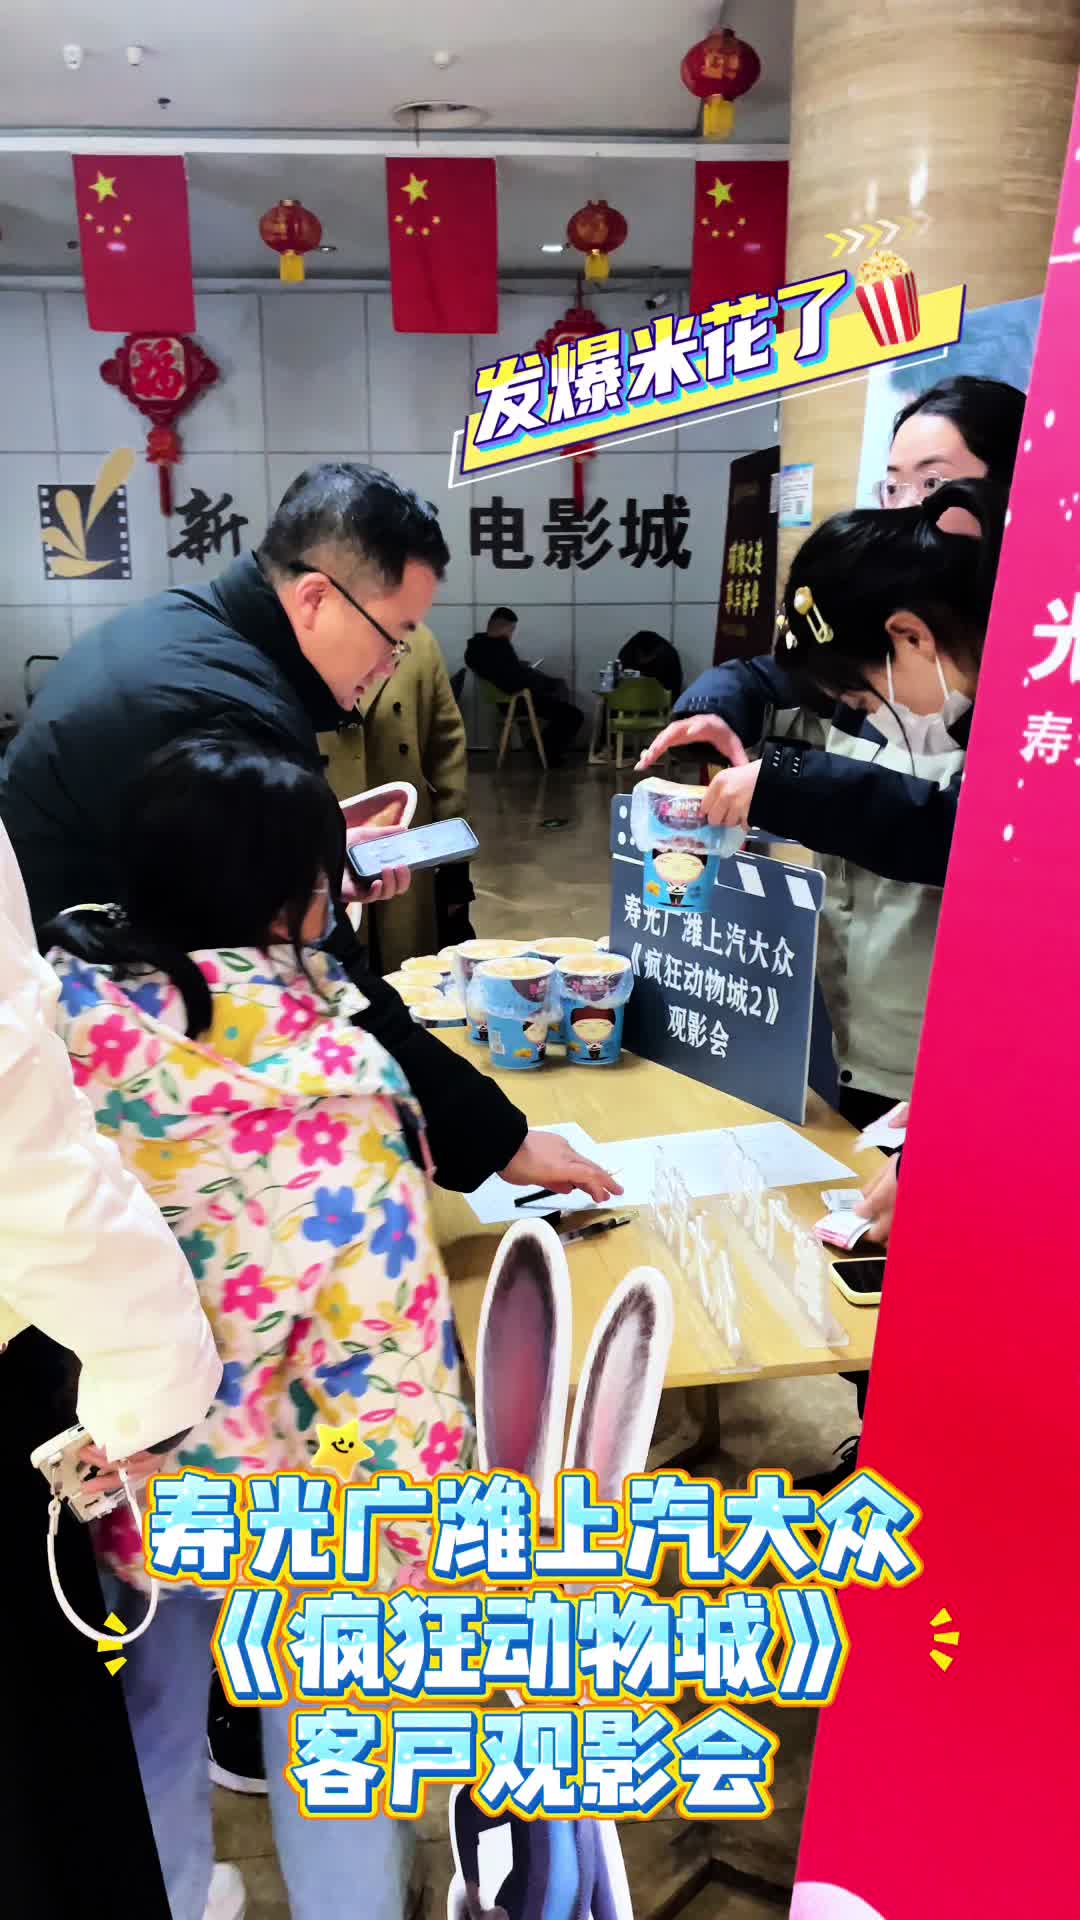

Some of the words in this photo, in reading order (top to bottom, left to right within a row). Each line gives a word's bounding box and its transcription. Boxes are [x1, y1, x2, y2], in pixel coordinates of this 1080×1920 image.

[469, 493, 693, 570] 电影城
[1019, 711, 1080, 765] 寿
[624, 893, 796, 978] 寿光广潍上汽大众
[631, 942, 780, 1026] 《疯狂动物城2》
[667, 1004, 730, 1059] 观影会
